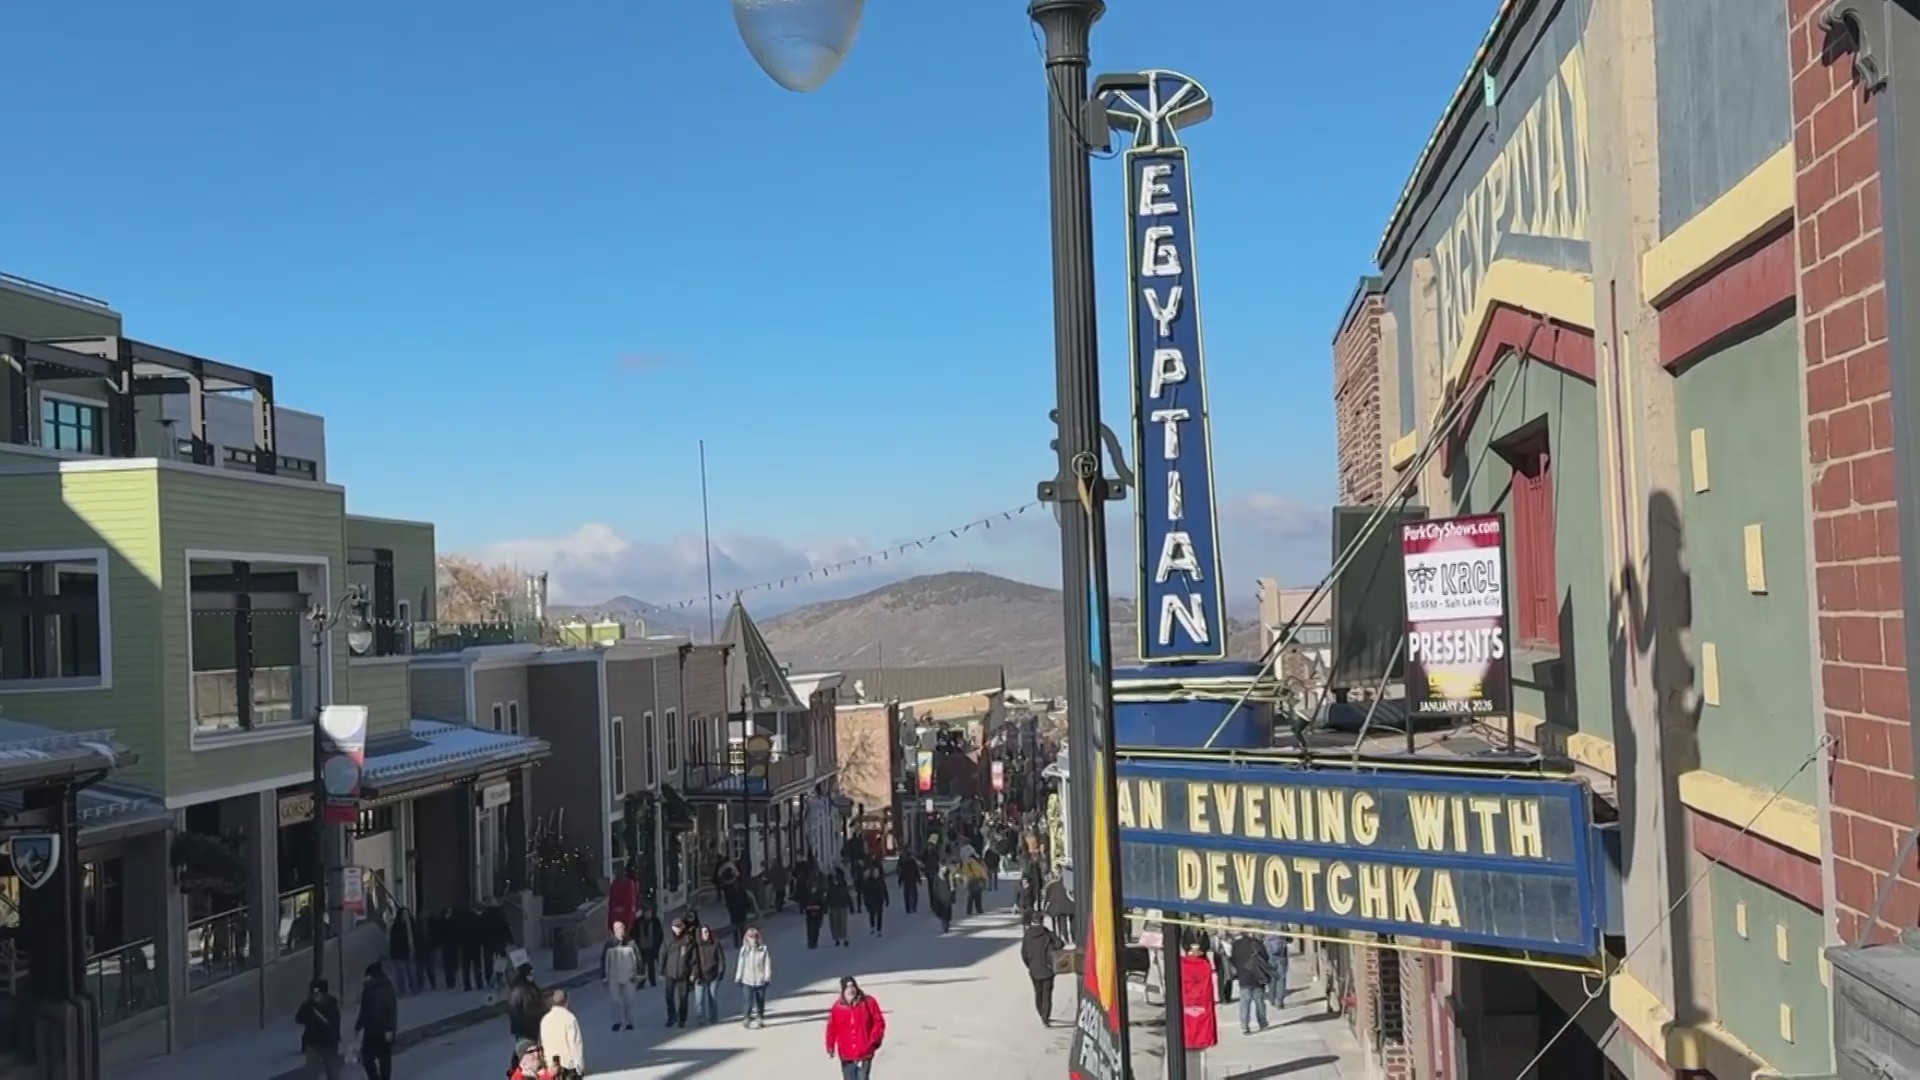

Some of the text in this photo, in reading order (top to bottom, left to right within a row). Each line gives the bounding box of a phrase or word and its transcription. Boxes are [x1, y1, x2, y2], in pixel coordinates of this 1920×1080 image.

[1139, 164, 1209, 645] EGYPTIAN
[1441, 560, 1500, 595] KRCL
[1408, 627, 1505, 662] PRESENTS
[1117, 780, 1543, 858] AN EVENING WITH
[1178, 849, 1461, 928] DEVOTCHKA
